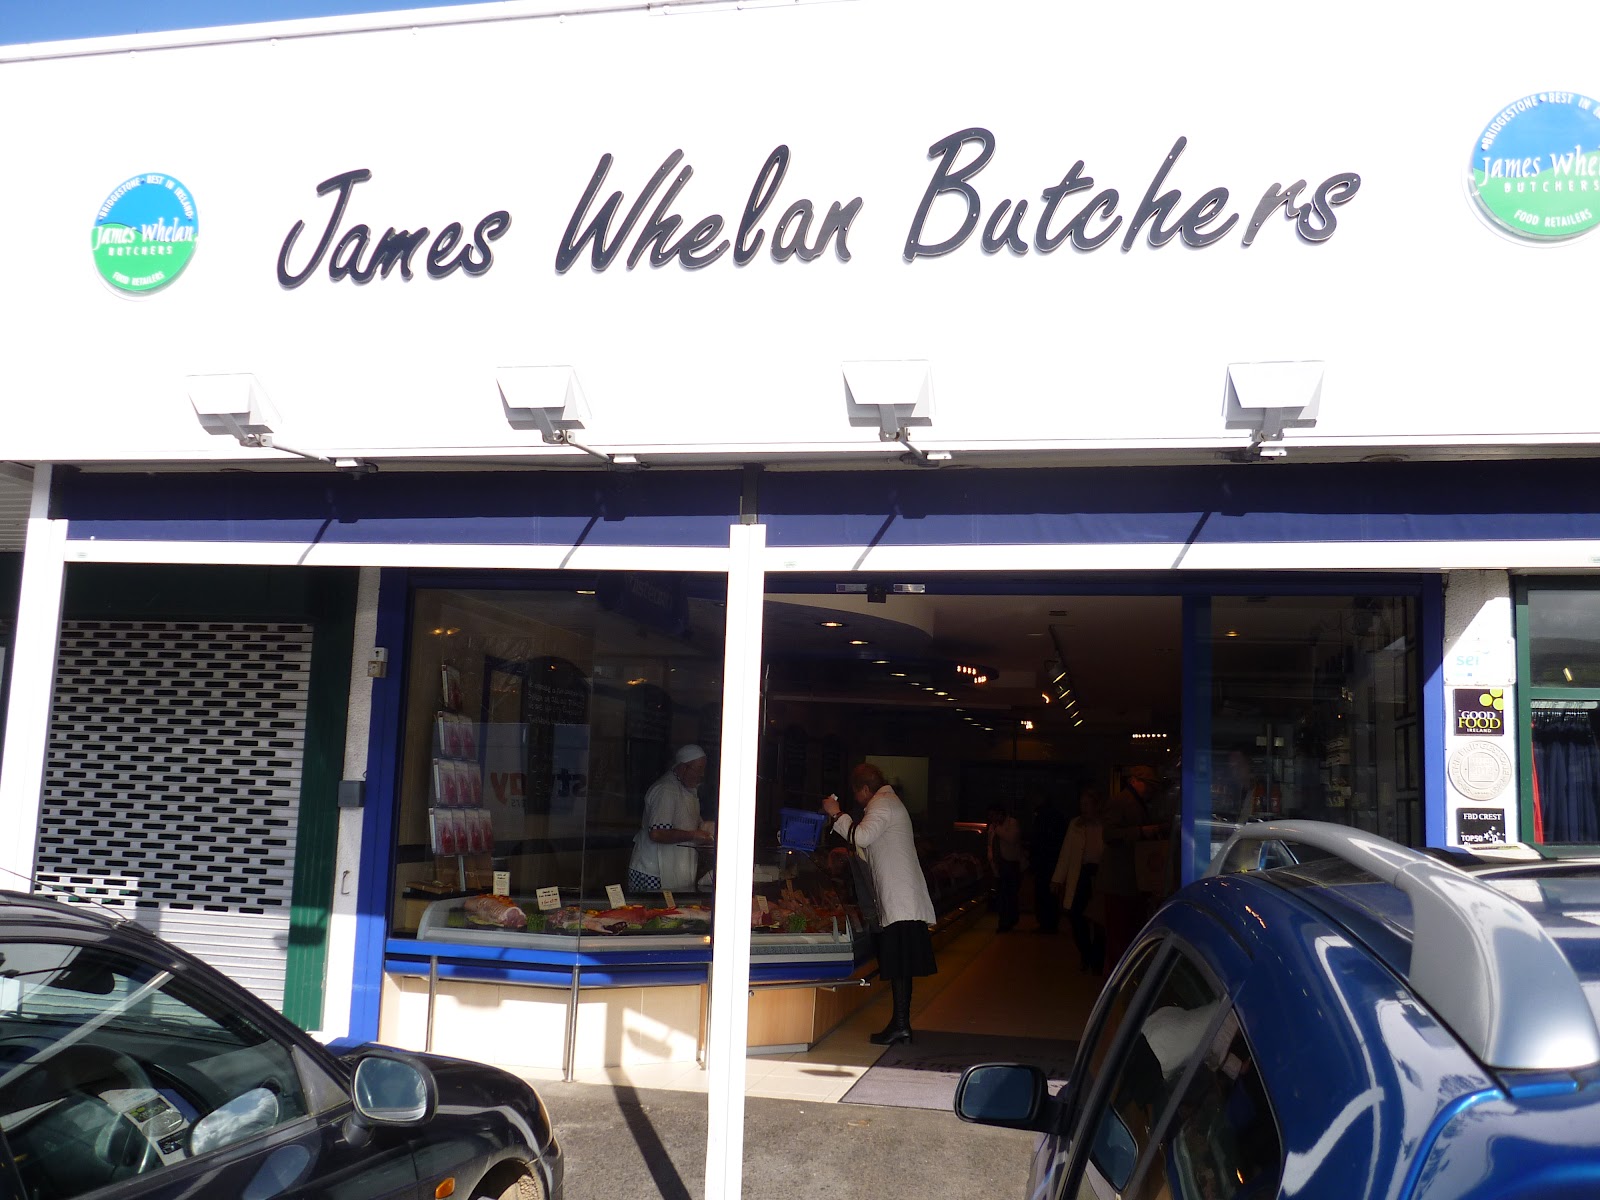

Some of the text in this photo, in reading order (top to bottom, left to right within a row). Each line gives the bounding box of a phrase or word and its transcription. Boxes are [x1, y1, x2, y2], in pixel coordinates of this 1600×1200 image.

[1482, 91, 1592, 146] BRIDGESTONE BEST IN
[1478, 144, 1600, 187] James Whe
[1504, 179, 1600, 193] BUTCHERS
[100, 175, 194, 218] BRIDGESTONE BEST IN IRELAND
[276, 127, 1362, 290] James Whelan Butchers
[1514, 207, 1593, 228] FOOD RETAILERS
[92, 216, 195, 251] James Whelan
[108, 246, 173, 256] BUTCHERS
[112, 271, 165, 286] FOOD RETAILERS
[1458, 717, 1501, 729] FOOD
[1461, 710, 1496, 719] GOOD
[1463, 812, 1502, 821] FBD CREST
